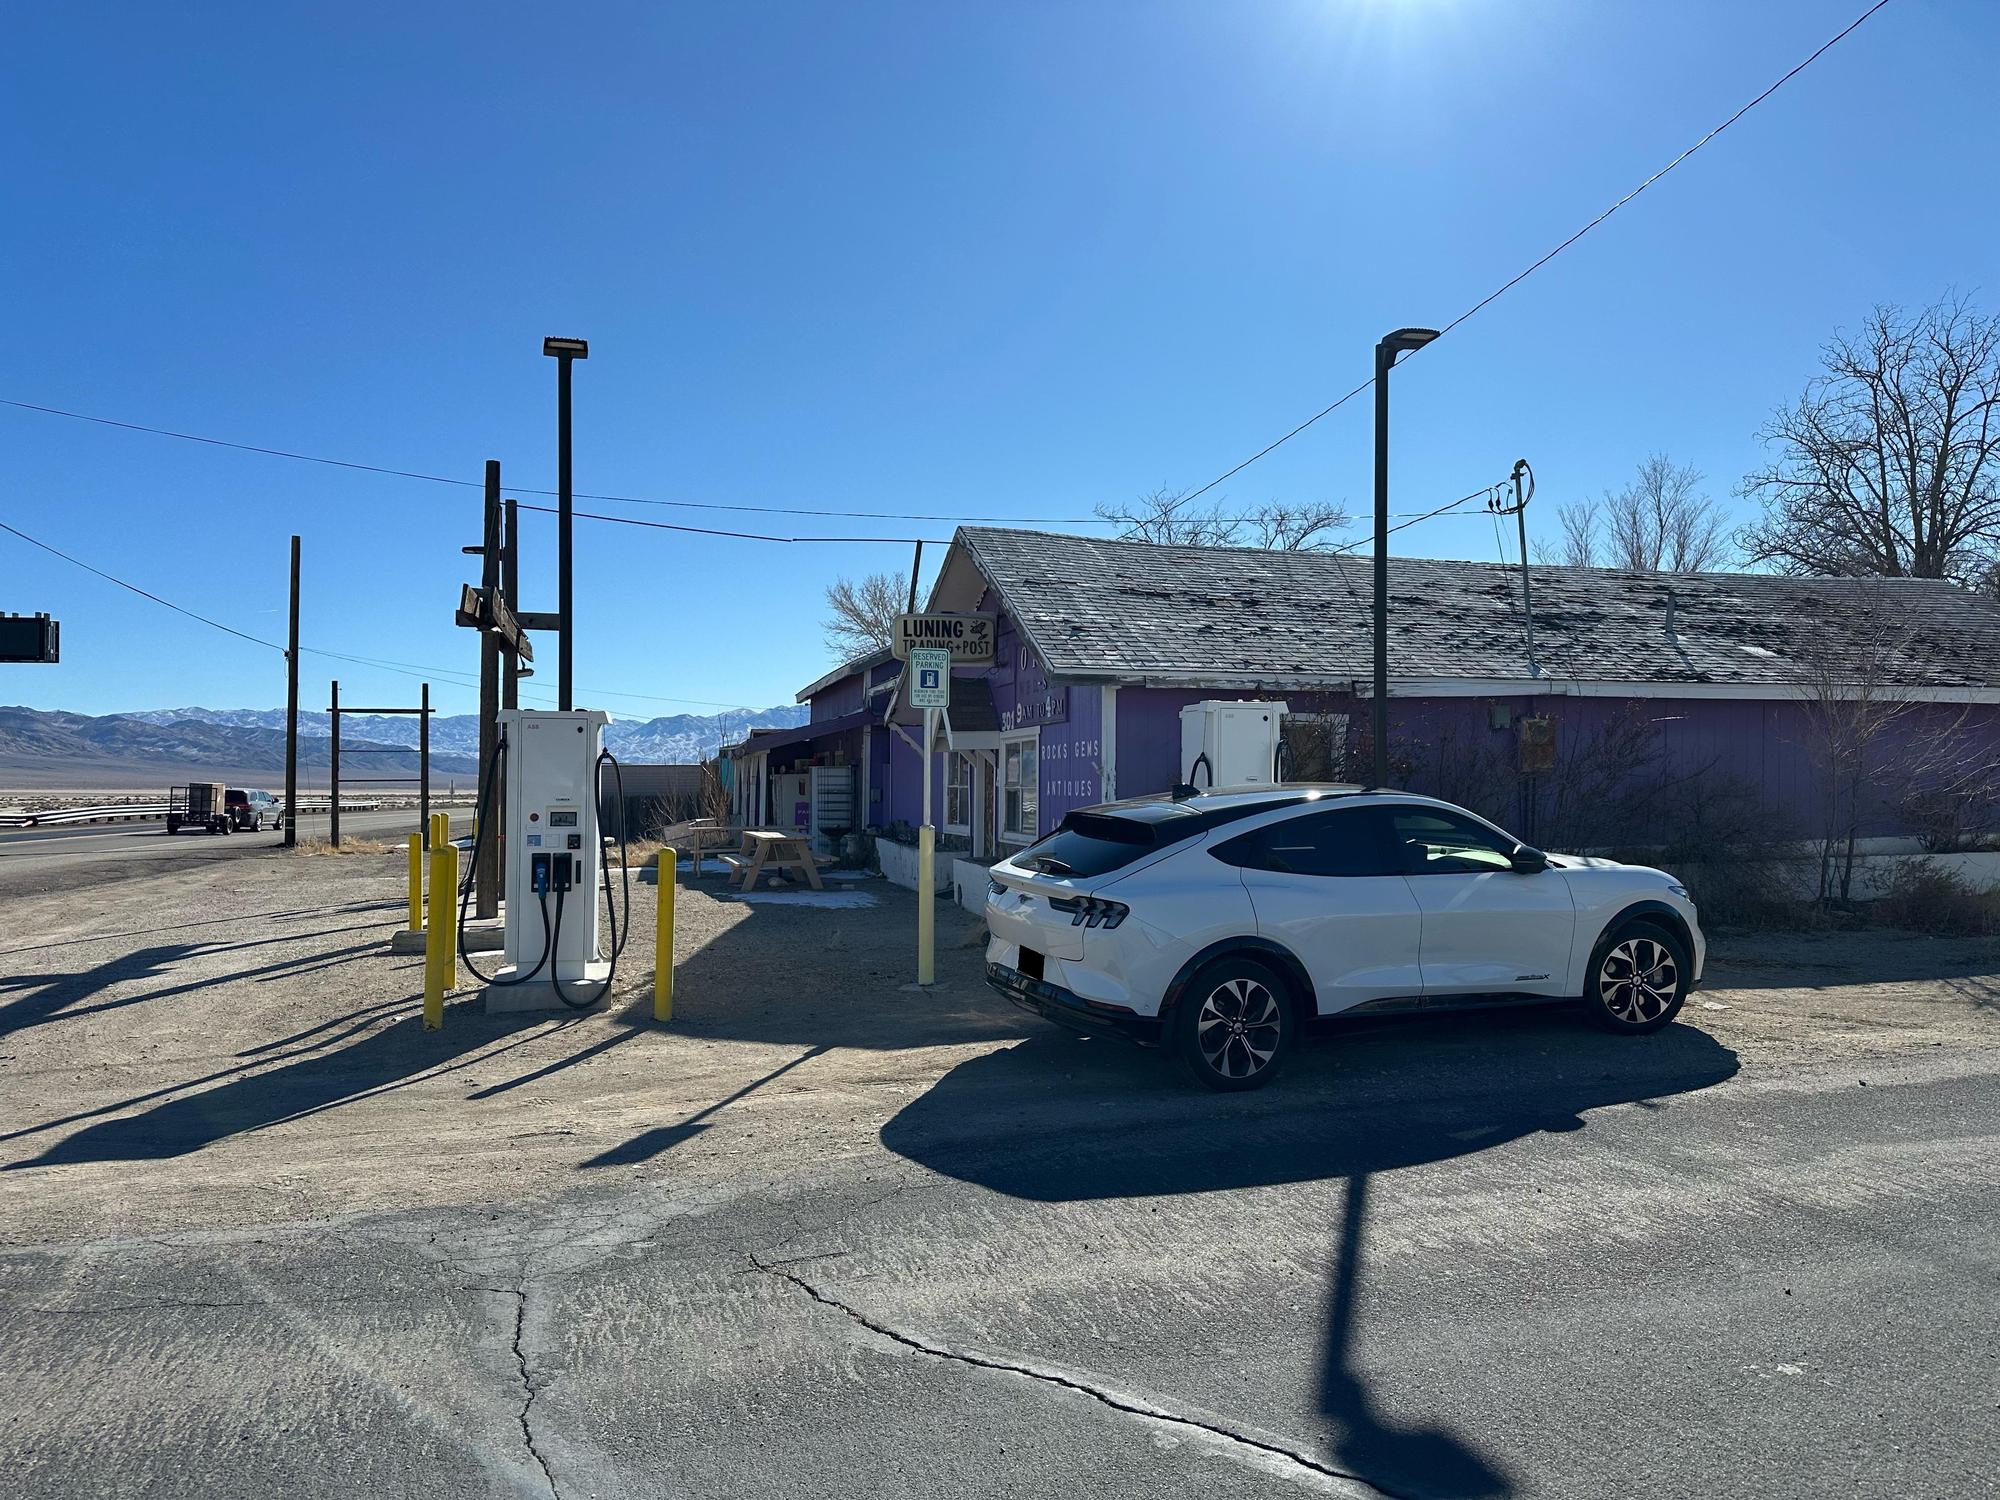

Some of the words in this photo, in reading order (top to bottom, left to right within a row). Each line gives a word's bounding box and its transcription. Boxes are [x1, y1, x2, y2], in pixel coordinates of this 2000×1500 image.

[903, 619, 963, 638] LUNING
[913, 652, 947, 661] RESERVED
[915, 660, 944, 669] PARKING
[1041, 743, 1068, 760] ROCKS
[1074, 740, 1099, 758] GEMS
[1046, 780, 1092, 797] ANTIQUES
